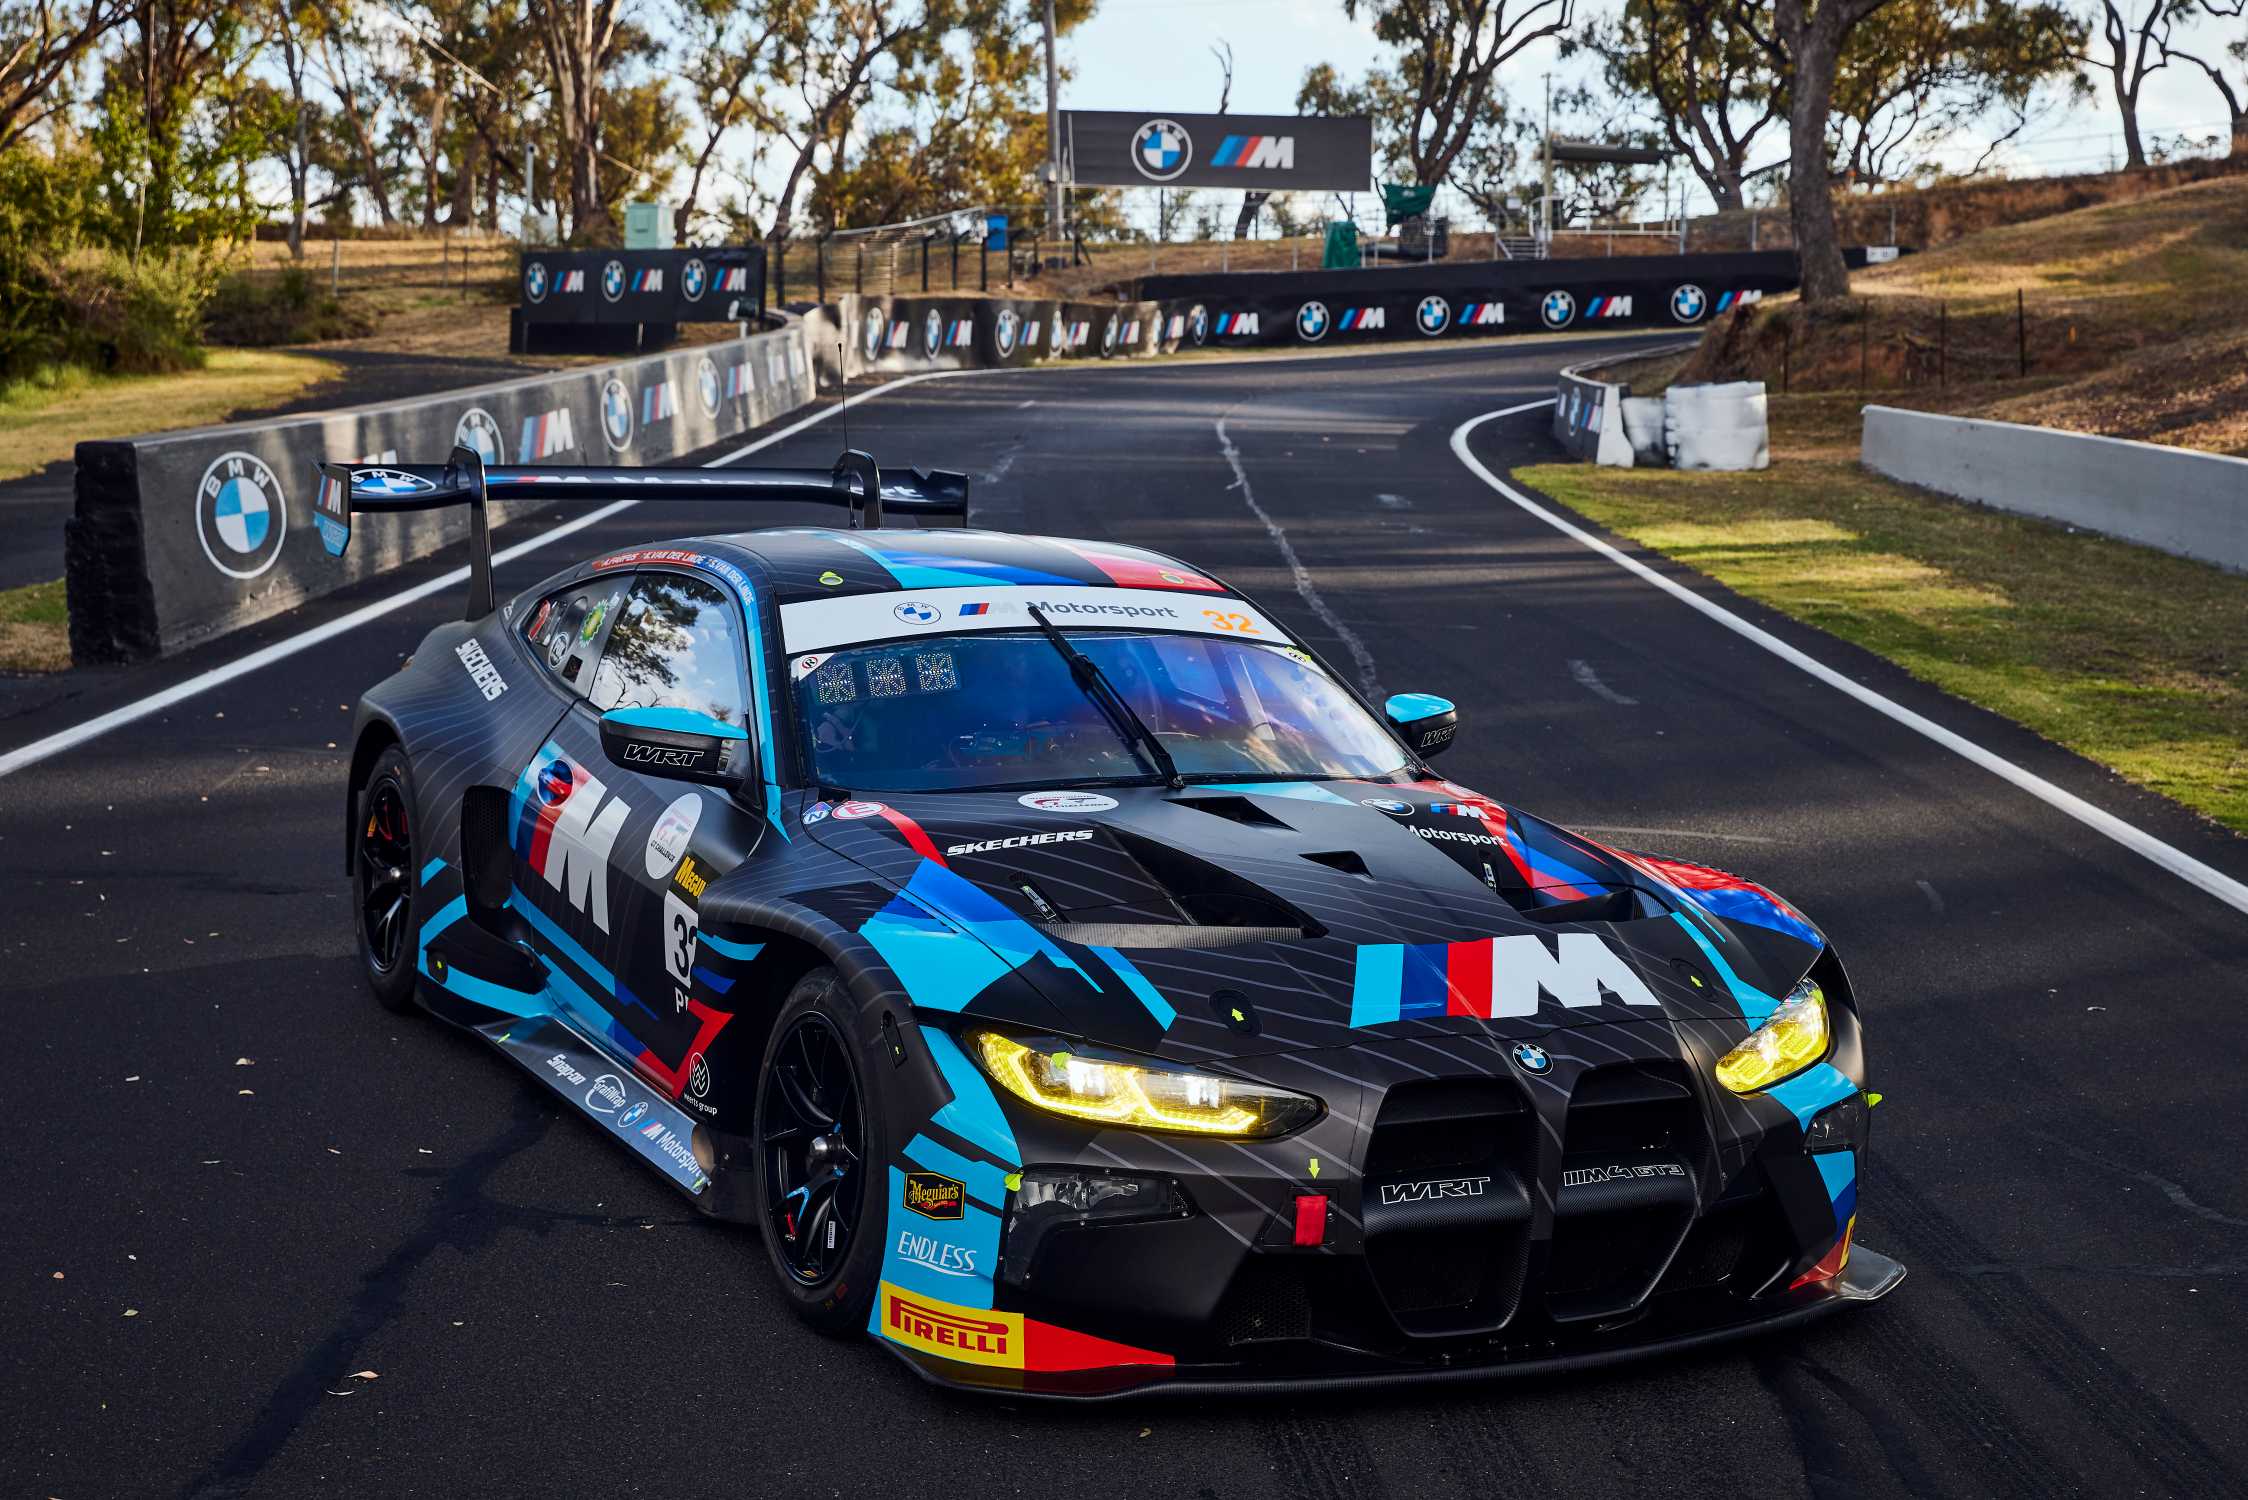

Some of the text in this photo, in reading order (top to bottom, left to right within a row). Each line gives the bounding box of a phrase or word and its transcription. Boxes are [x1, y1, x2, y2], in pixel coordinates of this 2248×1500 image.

[1246, 136, 1294, 169] M
[1357, 307, 1385, 329] M
[1477, 303, 1504, 324] M
[1604, 296, 1632, 317] M
[1232, 313, 1260, 335] M
[543, 407, 575, 458] M
[205, 458, 271, 499] BMW
[1026, 601, 1179, 619] Motorsport
[1201, 609, 1264, 635] 32
[455, 637, 510, 702] SKECHERS
[623, 743, 705, 768] WRT
[1456, 802, 1491, 821] M
[544, 775, 632, 936] M
[946, 829, 1094, 857] SKECHERS
[1490, 932, 1661, 1019] M
[698, 1102, 718, 1117] group
[656, 1130, 703, 1178] Motorsport
[909, 1179, 960, 1207] Meguiar's
[1381, 1176, 1491, 1205] WRT
[897, 1230, 978, 1272] ENDLESS
[889, 1295, 1010, 1355] PIRELLI
